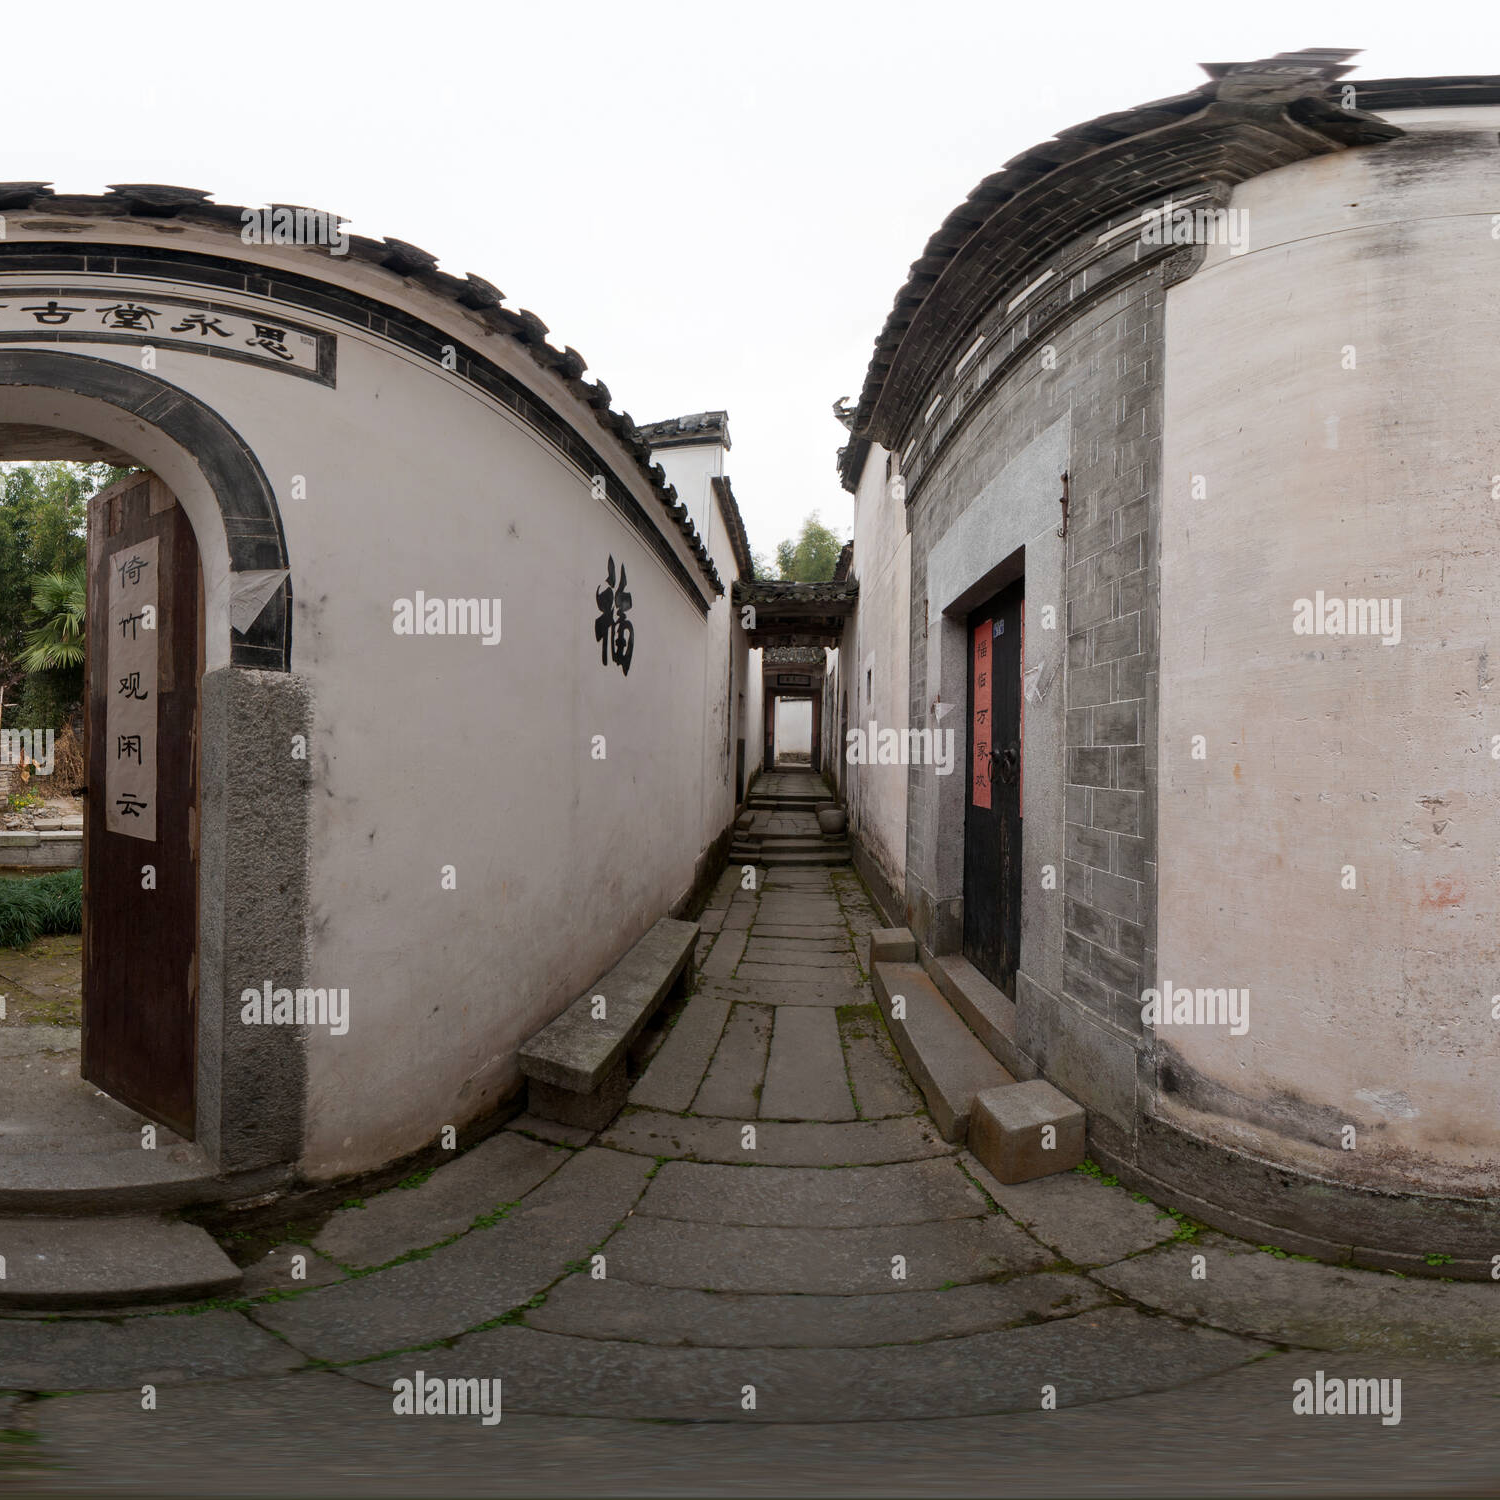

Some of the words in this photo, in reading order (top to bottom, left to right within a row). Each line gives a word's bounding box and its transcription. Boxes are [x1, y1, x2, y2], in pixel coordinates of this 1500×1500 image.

[116, 555, 149, 817] 倚竹观闲云
[594, 553, 635, 677] 福
